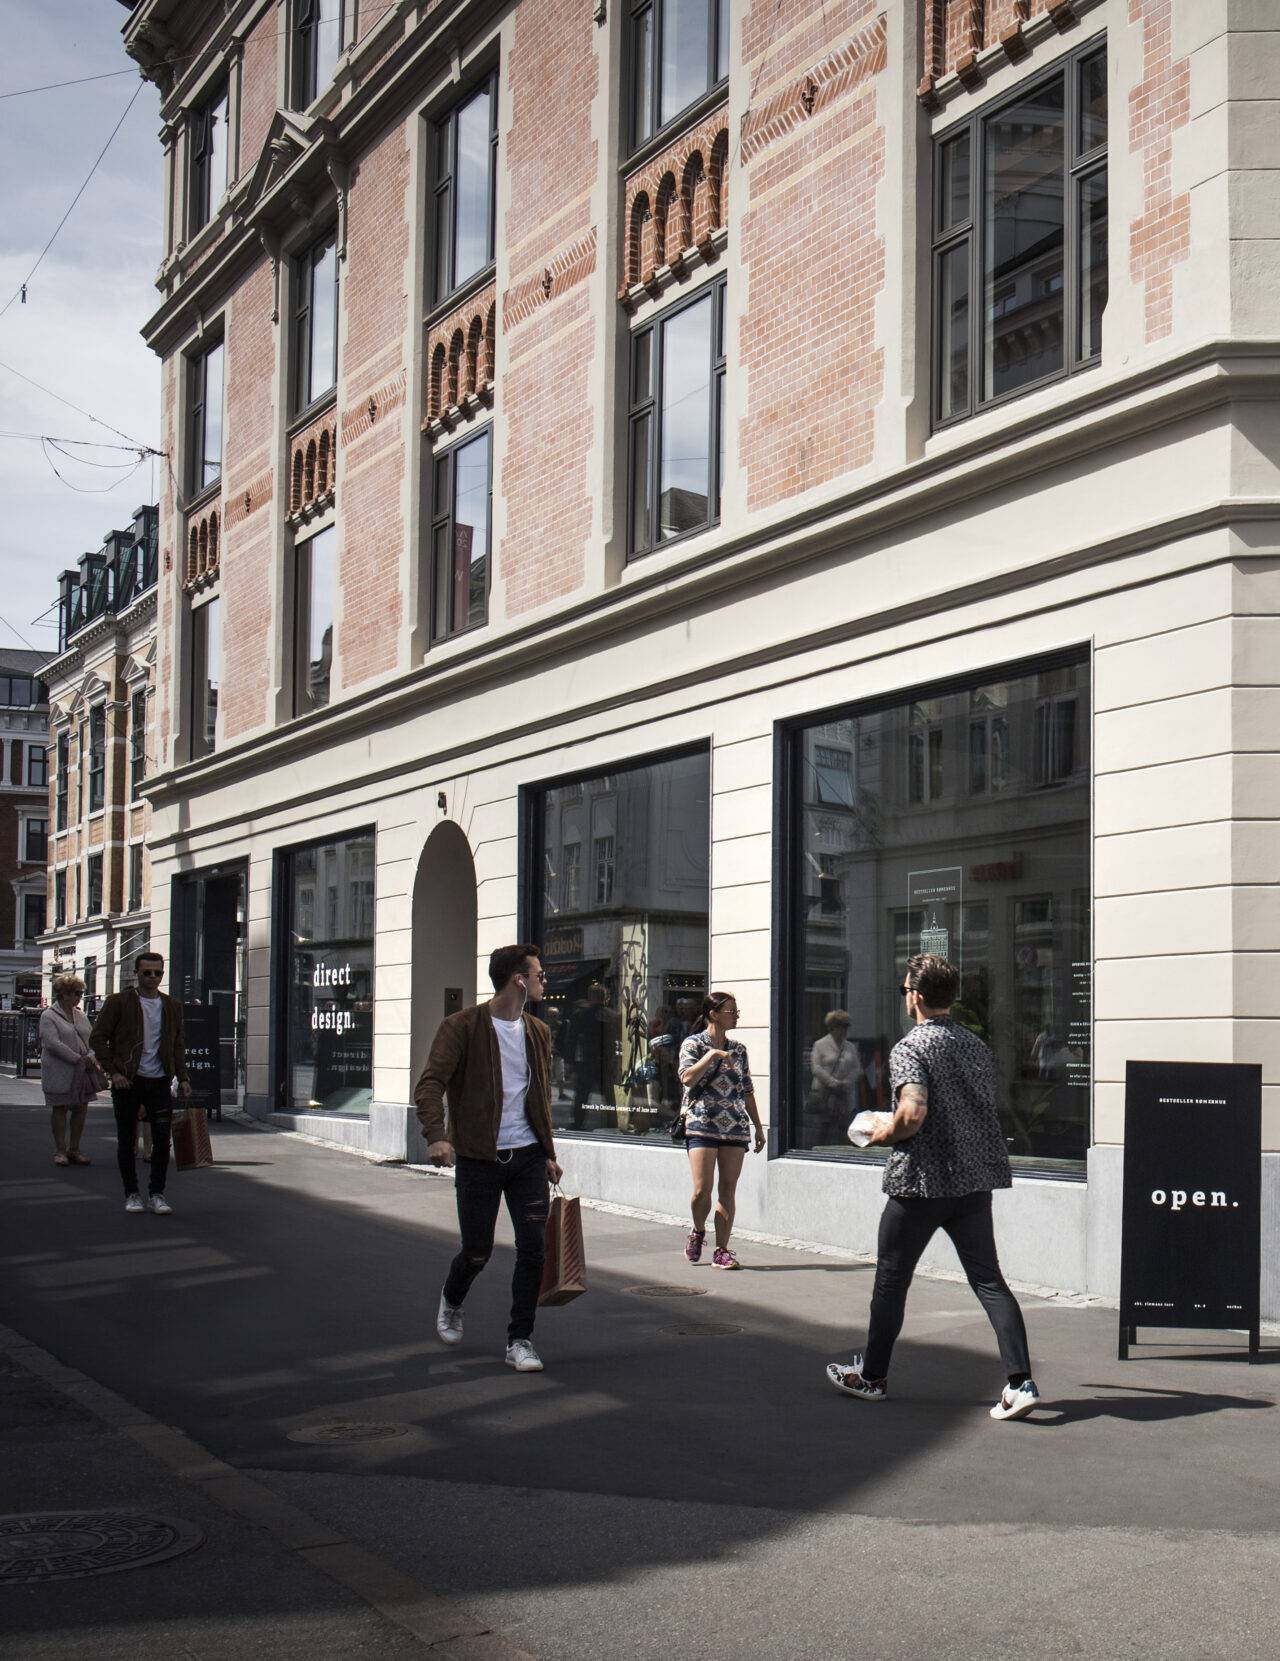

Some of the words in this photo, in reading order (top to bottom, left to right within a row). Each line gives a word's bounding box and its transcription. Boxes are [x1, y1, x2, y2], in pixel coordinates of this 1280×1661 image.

[313, 962, 351, 987] direct
[311, 1004, 356, 1036] design.
[1151, 1189, 1239, 1210] open.
